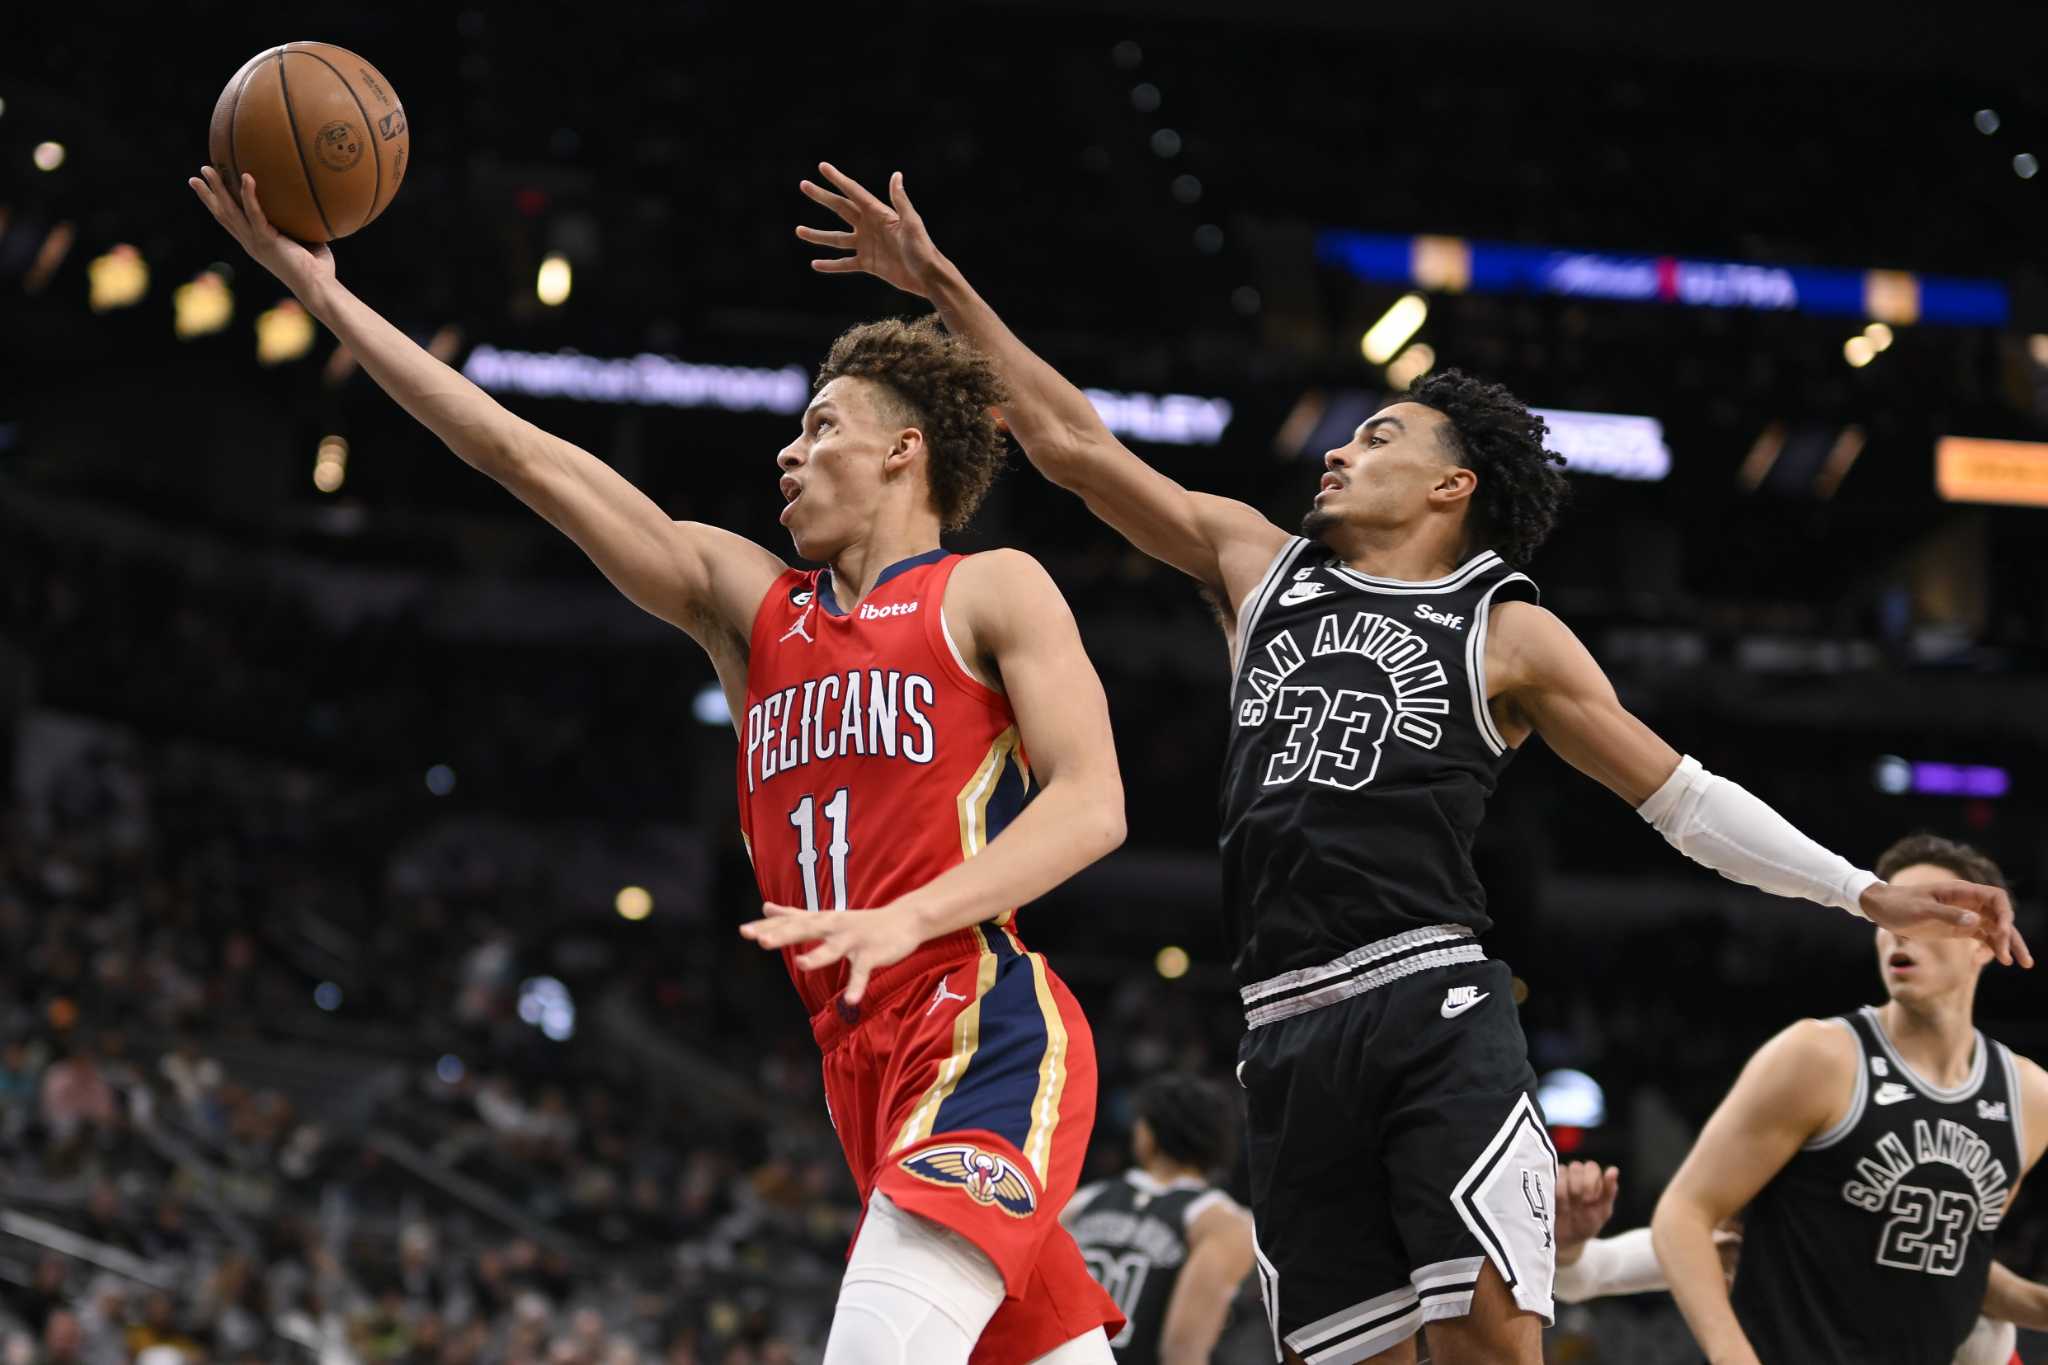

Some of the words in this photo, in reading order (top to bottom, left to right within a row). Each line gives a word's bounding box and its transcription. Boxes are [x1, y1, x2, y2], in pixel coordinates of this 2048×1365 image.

[793, 591, 814, 606] 6
[860, 601, 918, 620] ibotta
[1293, 567, 1316, 581] 6
[1238, 630, 1305, 726] SAN
[1312, 612, 1449, 750] ANTONIO
[745, 669, 935, 794] PELICANS
[1263, 686, 1394, 790] 33
[788, 787, 849, 913] 11
[1447, 986, 1478, 1006] NIKE
[1842, 1131, 1915, 1213] SAN
[1913, 1118, 2009, 1231] ANTONIO
[1876, 1184, 1978, 1277] 23
